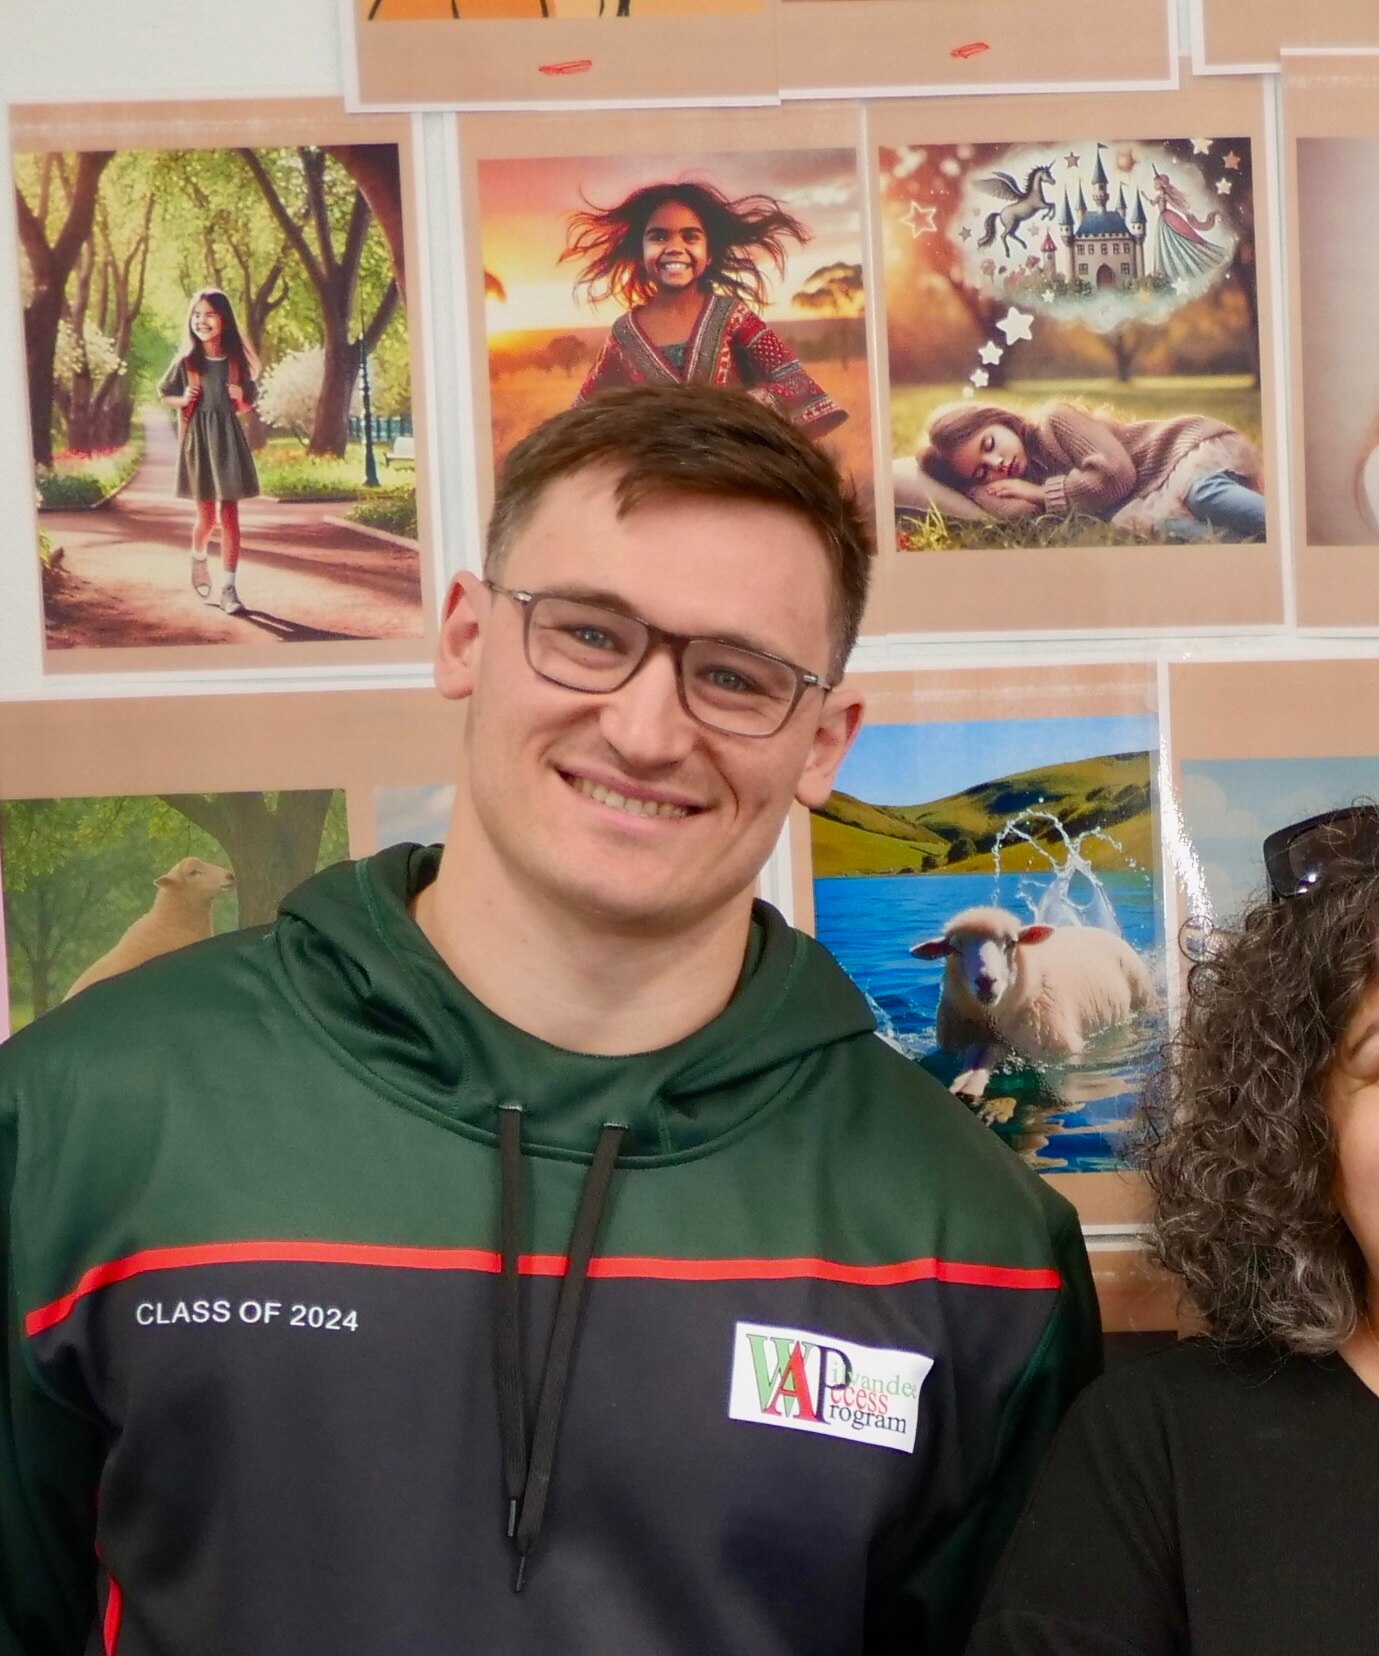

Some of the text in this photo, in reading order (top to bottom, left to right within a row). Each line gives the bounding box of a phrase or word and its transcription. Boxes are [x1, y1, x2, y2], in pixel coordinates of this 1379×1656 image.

[136, 1301, 358, 1331] CLASS OF 2024
